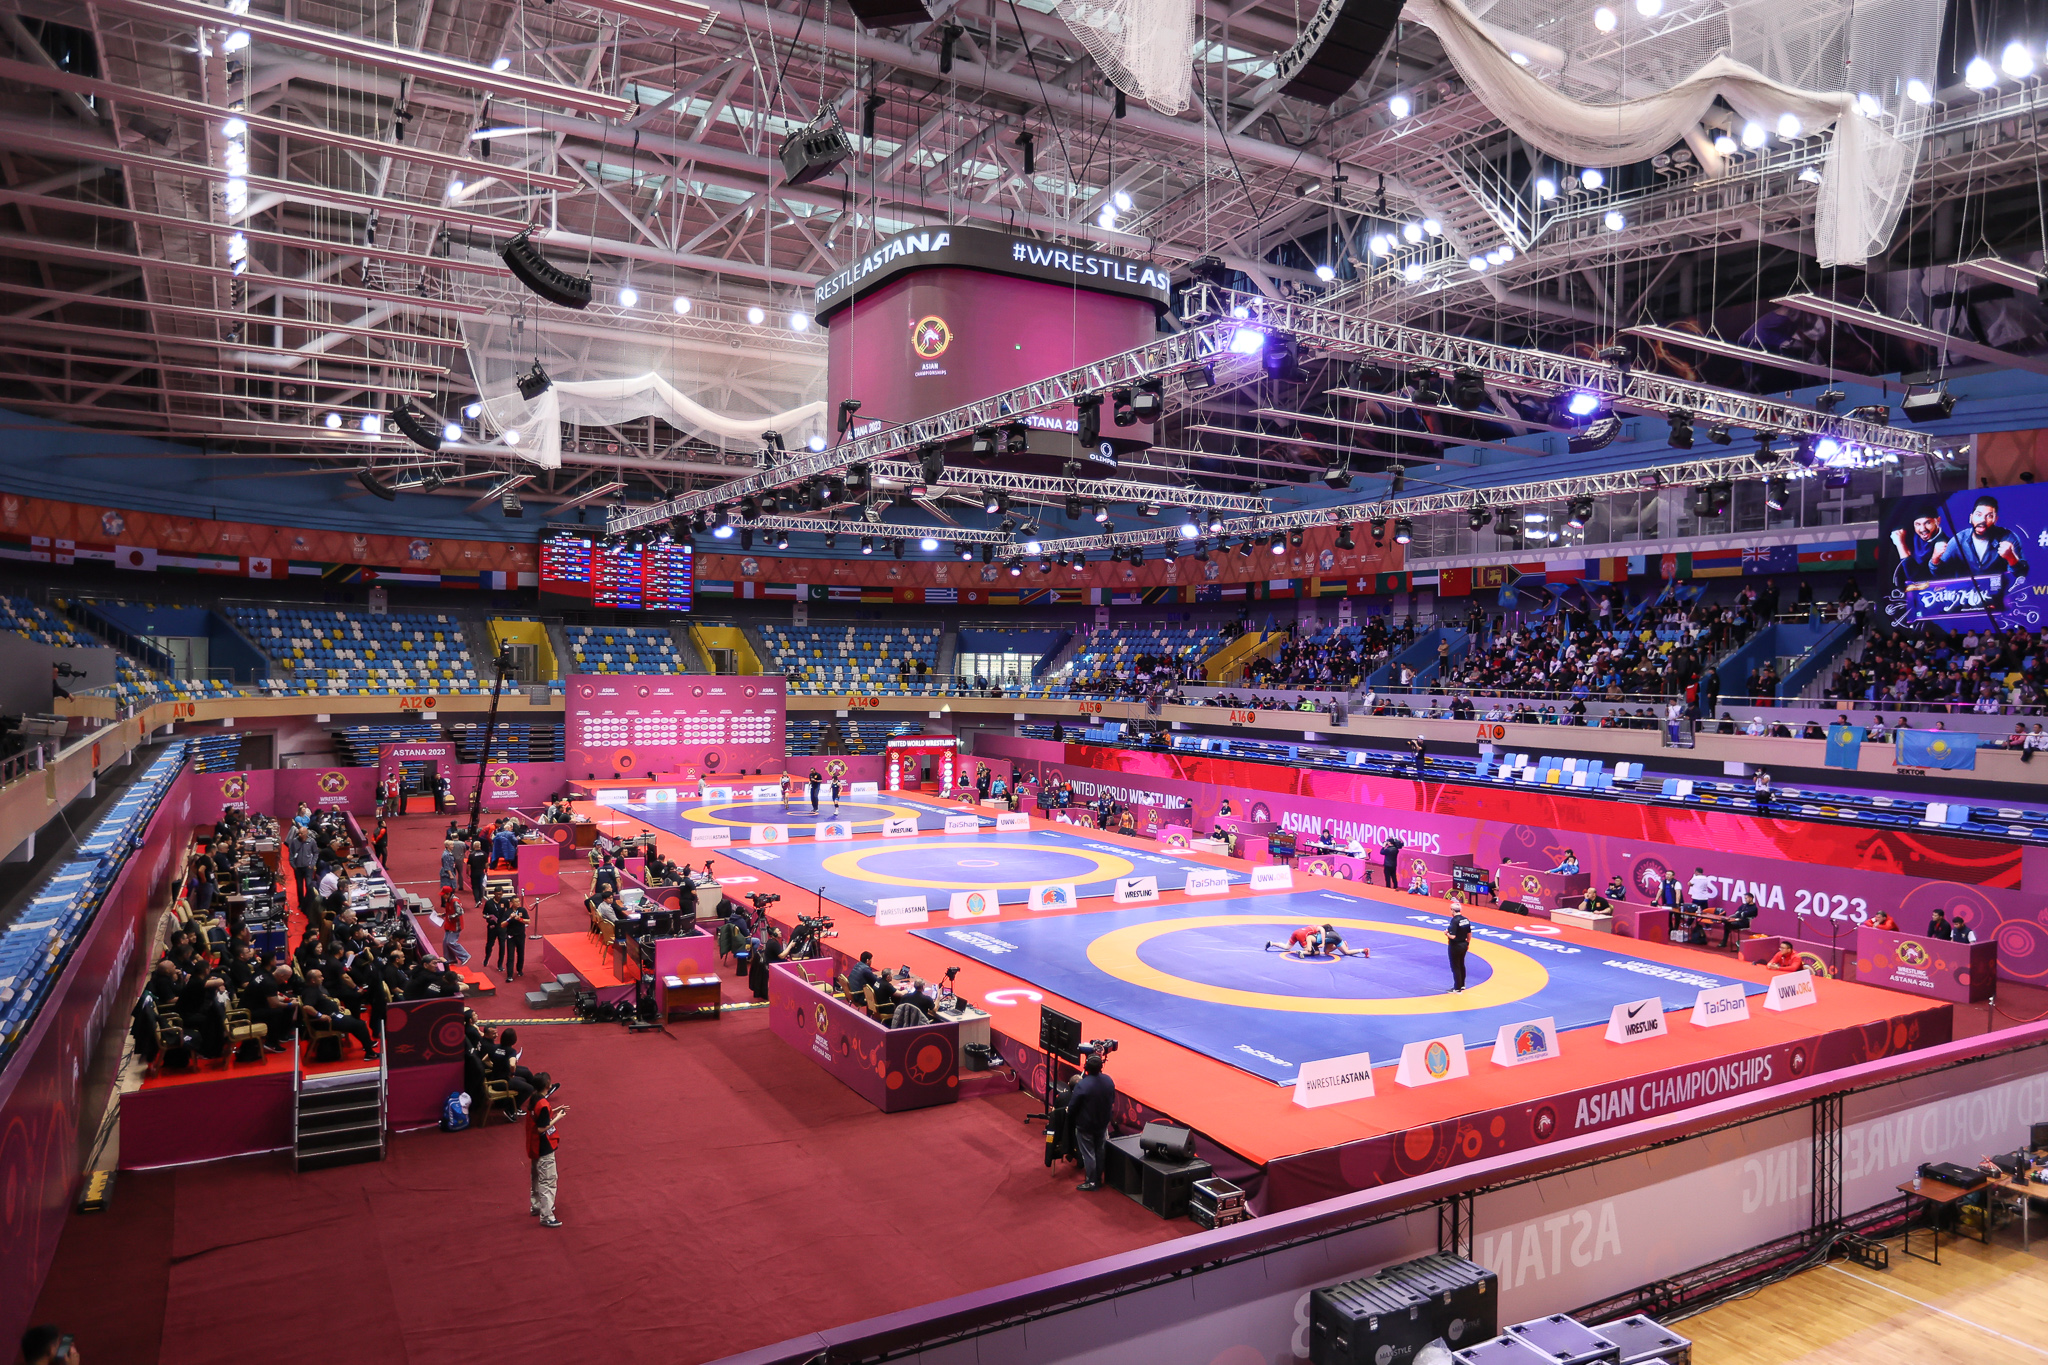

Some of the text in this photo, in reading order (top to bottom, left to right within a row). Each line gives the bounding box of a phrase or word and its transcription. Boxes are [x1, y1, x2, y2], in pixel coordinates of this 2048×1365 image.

[921, 362, 939, 370] ASIAN
[868, 420, 882, 433] 2023
[1918, 590, 1959, 612] Dairy
[887, 739, 956, 748] UNITED WORLD WRESTLING
[393, 748, 446, 757] ASTANA 2023
[1896, 768, 1926, 777] SEKTOR
[948, 820, 978, 829] TaiShan
[1000, 818, 1028, 826] UWW.ORG
[1281, 811, 1322, 836] ASIAN
[1191, 878, 1227, 888] TaiShan
[1124, 889, 1152, 899] WRESTLING
[1688, 875, 1868, 923] STANA 2023
[1511, 937, 1581, 954] 2023
[1602, 960, 1721, 989] WRESTLING
[1897, 966, 1927, 976] WRESTLING
[1889, 975, 1935, 988] ASTANA 2023
[1778, 981, 1812, 999] UWW.ORG
[1704, 998, 1745, 1014] TaiShan
[1625, 1018, 1658, 1036] WRESTLING
[1306, 1070, 1371, 1091] #WRESTLEASTANA
[1574, 1053, 1772, 1129] ASIAN CHAMPIONSHIPS
